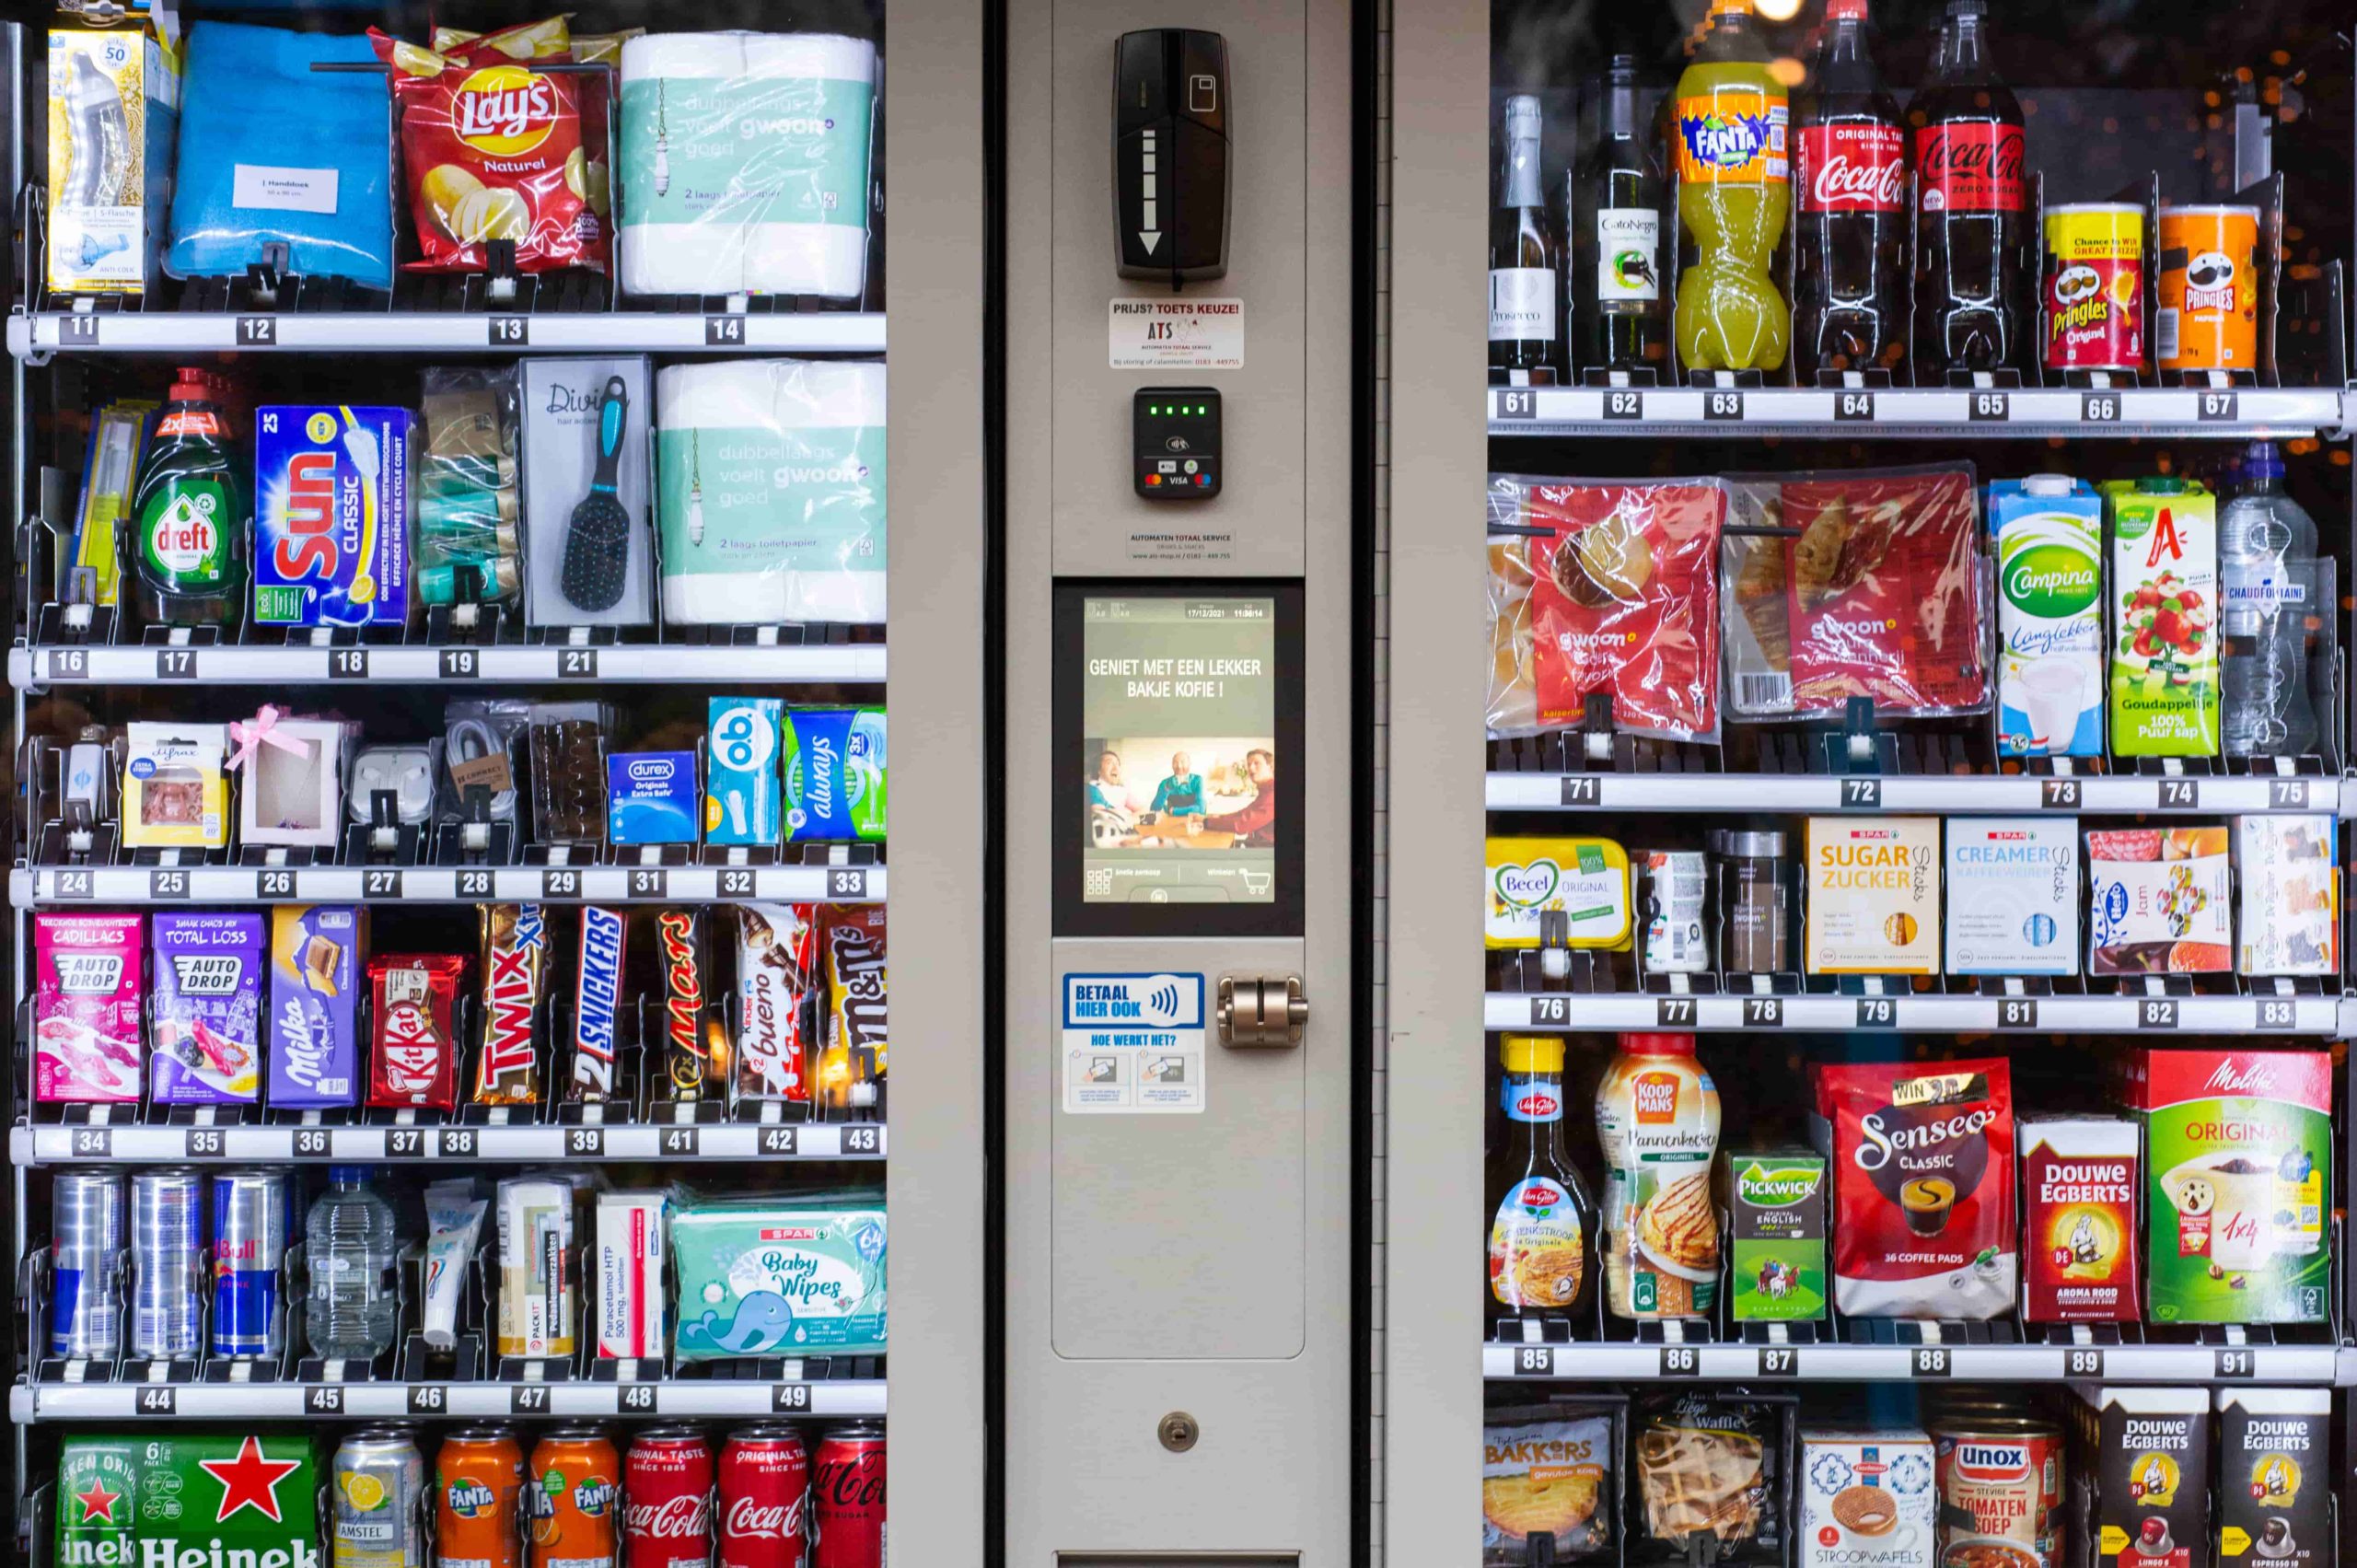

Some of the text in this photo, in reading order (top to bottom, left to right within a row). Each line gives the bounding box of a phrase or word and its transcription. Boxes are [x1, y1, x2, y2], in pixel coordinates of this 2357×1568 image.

[462, 81, 551, 137] Lay's
[1696, 123, 1759, 157] FANTA
[1798, 133, 1805, 153] ME
[1836, 129, 1889, 141] ORIGINAL
[483, 158, 546, 174] Naturel
[1113, 304, 1239, 314] PRIJS? TOETS KEUZE!
[2186, 289, 2234, 311] PRINGLES
[71, 318, 94, 335] 11
[244, 319, 270, 339] 12
[496, 319, 522, 340] 13
[713, 319, 739, 340] 14
[2053, 297, 2108, 343] Pringles
[1147, 322, 1173, 340] ATS
[2066, 326, 2106, 345] Original
[1505, 391, 1529, 413] 61
[1611, 392, 1637, 413] 62
[1713, 393, 1738, 414] 63
[1843, 394, 1869, 415] 64
[1978, 394, 2003, 414] 65
[2088, 399, 2114, 420] 66
[2205, 393, 2232, 415] 67
[263, 412, 278, 434] 25
[1169, 477, 1188, 485] VISA
[275, 451, 337, 581] Sun
[343, 475, 359, 554] CLASSIC
[392, 436, 402, 587] EFFICACE MÊME EN CYCLE COURT
[157, 522, 209, 551] dreft
[760, 539, 818, 549] toiletpapier
[2010, 565, 2095, 600] Campina
[56, 650, 83, 672] 16
[164, 651, 191, 672] 17
[337, 651, 363, 672] 18
[447, 652, 472, 673] 19
[566, 651, 590, 671] 21
[1089, 659, 1261, 676] GENIET MET EEN LEKKER
[1127, 681, 1213, 698] BAKJE KOFIE
[2121, 697, 2213, 714] Goudappeltje
[2151, 714, 2186, 727] 100%
[2138, 726, 2199, 740] Puur sap
[633, 762, 669, 775] durex
[806, 735, 839, 819] always
[1570, 778, 1593, 799] 71
[1849, 781, 1875, 801] 72
[2049, 782, 2075, 803] 73
[2165, 782, 2192, 803] 74
[2277, 783, 2304, 804] 75
[1820, 845, 1910, 867] SUGAR
[1956, 847, 2050, 864] CREAMER
[62, 873, 88, 893] 24
[157, 872, 183, 893] 25
[264, 872, 290, 893] 26
[369, 872, 395, 892] 27
[462, 872, 488, 893] 28
[549, 872, 575, 892] 29
[635, 871, 659, 891] 31
[725, 871, 750, 892] 32
[835, 871, 862, 893] 33
[1506, 875, 1549, 891] Becel
[1562, 881, 1609, 893] ORIGINAL
[1821, 869, 1910, 889] ZUCKER
[2136, 884, 2149, 918] Jam
[52, 930, 125, 944] CADILLACS
[166, 931, 247, 945] TOTAL LOSS
[192, 959, 236, 972] AUTO
[188, 974, 232, 988] DROP
[578, 909, 622, 1054] SNICKERS
[659, 911, 708, 1060] Mars
[1075, 985, 1129, 1001] BETAAL
[750, 973, 779, 1057] bueno
[1075, 1002, 1142, 1017] HIER OOK
[1538, 998, 1564, 1019] 76
[1665, 1000, 1690, 1020] 77
[1750, 1000, 1777, 1021] 78
[1864, 1000, 1890, 1021] 79
[2007, 1002, 2030, 1022] 81
[2146, 1002, 2172, 1023] 82
[2264, 1002, 2291, 1023] 83
[279, 996, 322, 1087] Milka
[1091, 1035, 1177, 1046] HOE WERKT HET?
[1637, 1084, 1674, 1098] KOOP
[1896, 1083, 1924, 1100] WIN
[1637, 1098, 1673, 1112] MANS
[79, 1131, 105, 1152] 34
[192, 1131, 219, 1152] 35
[299, 1131, 325, 1152] 36
[392, 1131, 419, 1151] 37
[446, 1132, 471, 1152] 38
[573, 1130, 598, 1151] 39
[668, 1130, 691, 1150] 41
[766, 1129, 792, 1150] 42
[848, 1128, 876, 1150] 43
[1854, 1107, 1996, 1170] Senseo
[1660, 1153, 1695, 1162] ORIGINEEL
[1898, 1155, 1954, 1169] CLASSIC
[1738, 1179, 1816, 1196] PICKWICK
[2040, 1184, 2131, 1202] EGBERTS
[1757, 1215, 1802, 1225] ENGLISH
[772, 1230, 814, 1239] SPAR
[762, 1251, 818, 1277] Baby
[1898, 1253, 1964, 1264] COFFEE PADS
[548, 1234, 558, 1332] Pedaalemmerzakken
[604, 1246, 614, 1339] Paracetamol HTP
[772, 1274, 842, 1306] Wipes
[2057, 1287, 2119, 1298] AROMA ROOD
[617, 1319, 625, 1339] 500
[1523, 1348, 1549, 1369] 85
[1667, 1348, 1693, 1369] 86
[1766, 1350, 1792, 1370] 87
[1919, 1350, 1945, 1371] 88
[2073, 1351, 2098, 1372] 89
[2223, 1352, 2247, 1373] 91
[144, 1388, 170, 1409] 44
[312, 1388, 339, 1409] 45
[415, 1388, 441, 1408] 46
[519, 1388, 545, 1407] 47
[625, 1387, 652, 1407] 48
[780, 1386, 807, 1407] 49
[1696, 1416, 1742, 1430] Waffle
[670, 1447, 705, 1460] TASTE
[737, 1449, 794, 1462] ORIGINAL
[447, 1487, 493, 1506] FANTA
[1958, 1497, 2026, 1516] TOMATEN
[341, 1527, 382, 1538] AMSTEL
[1975, 1517, 2011, 1535] SOEP
[1816, 1549, 1923, 1565] STROOPWAFELS
